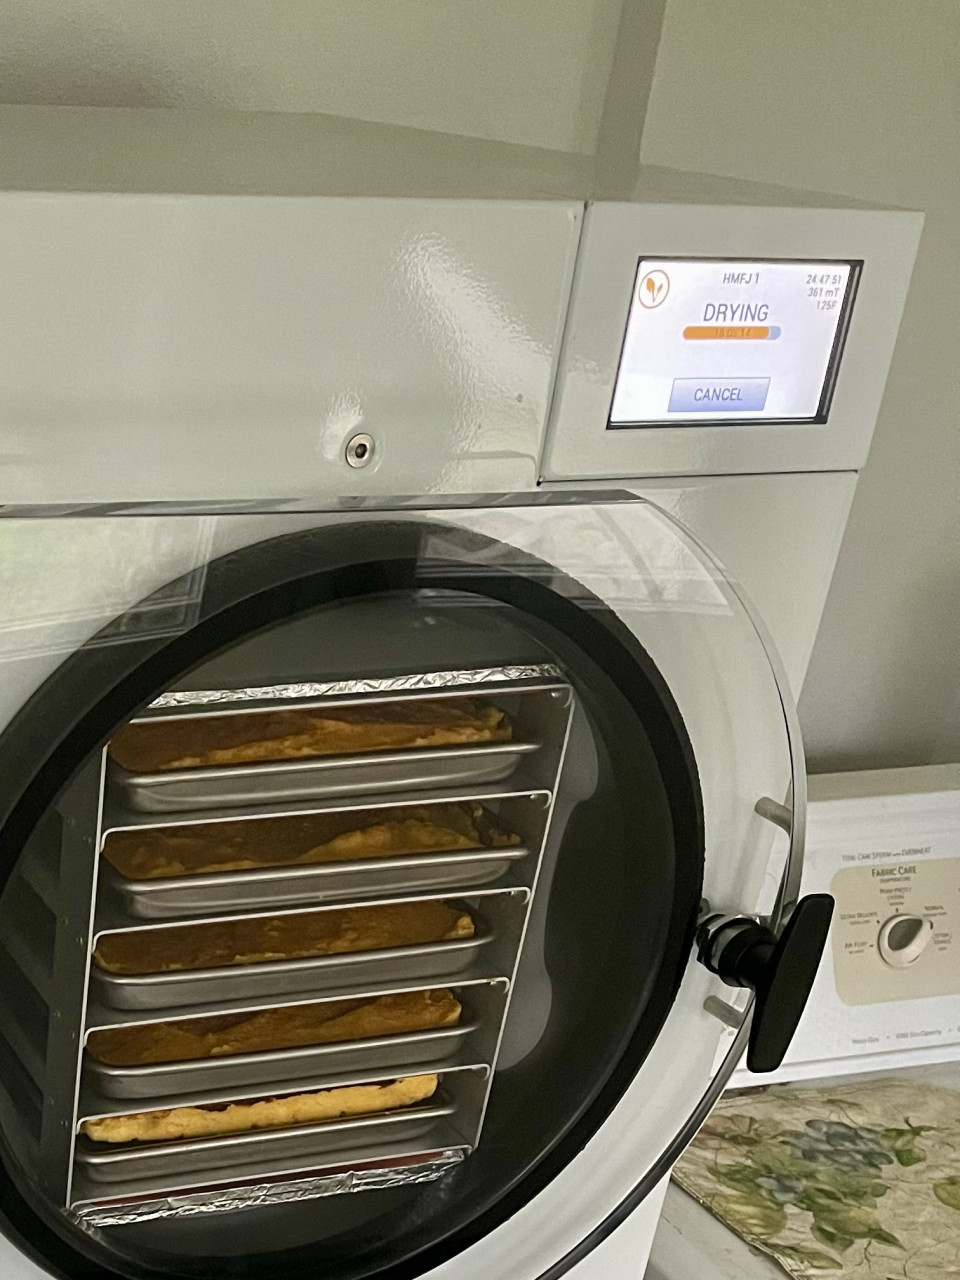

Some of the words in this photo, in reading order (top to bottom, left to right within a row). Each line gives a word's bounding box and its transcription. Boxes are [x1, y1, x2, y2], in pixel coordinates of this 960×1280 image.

[722, 272, 753, 285] HMFJ
[806, 274, 842, 285] 244751
[703, 303, 770, 323] DRYING
[693, 387, 744, 402] CANCEL
